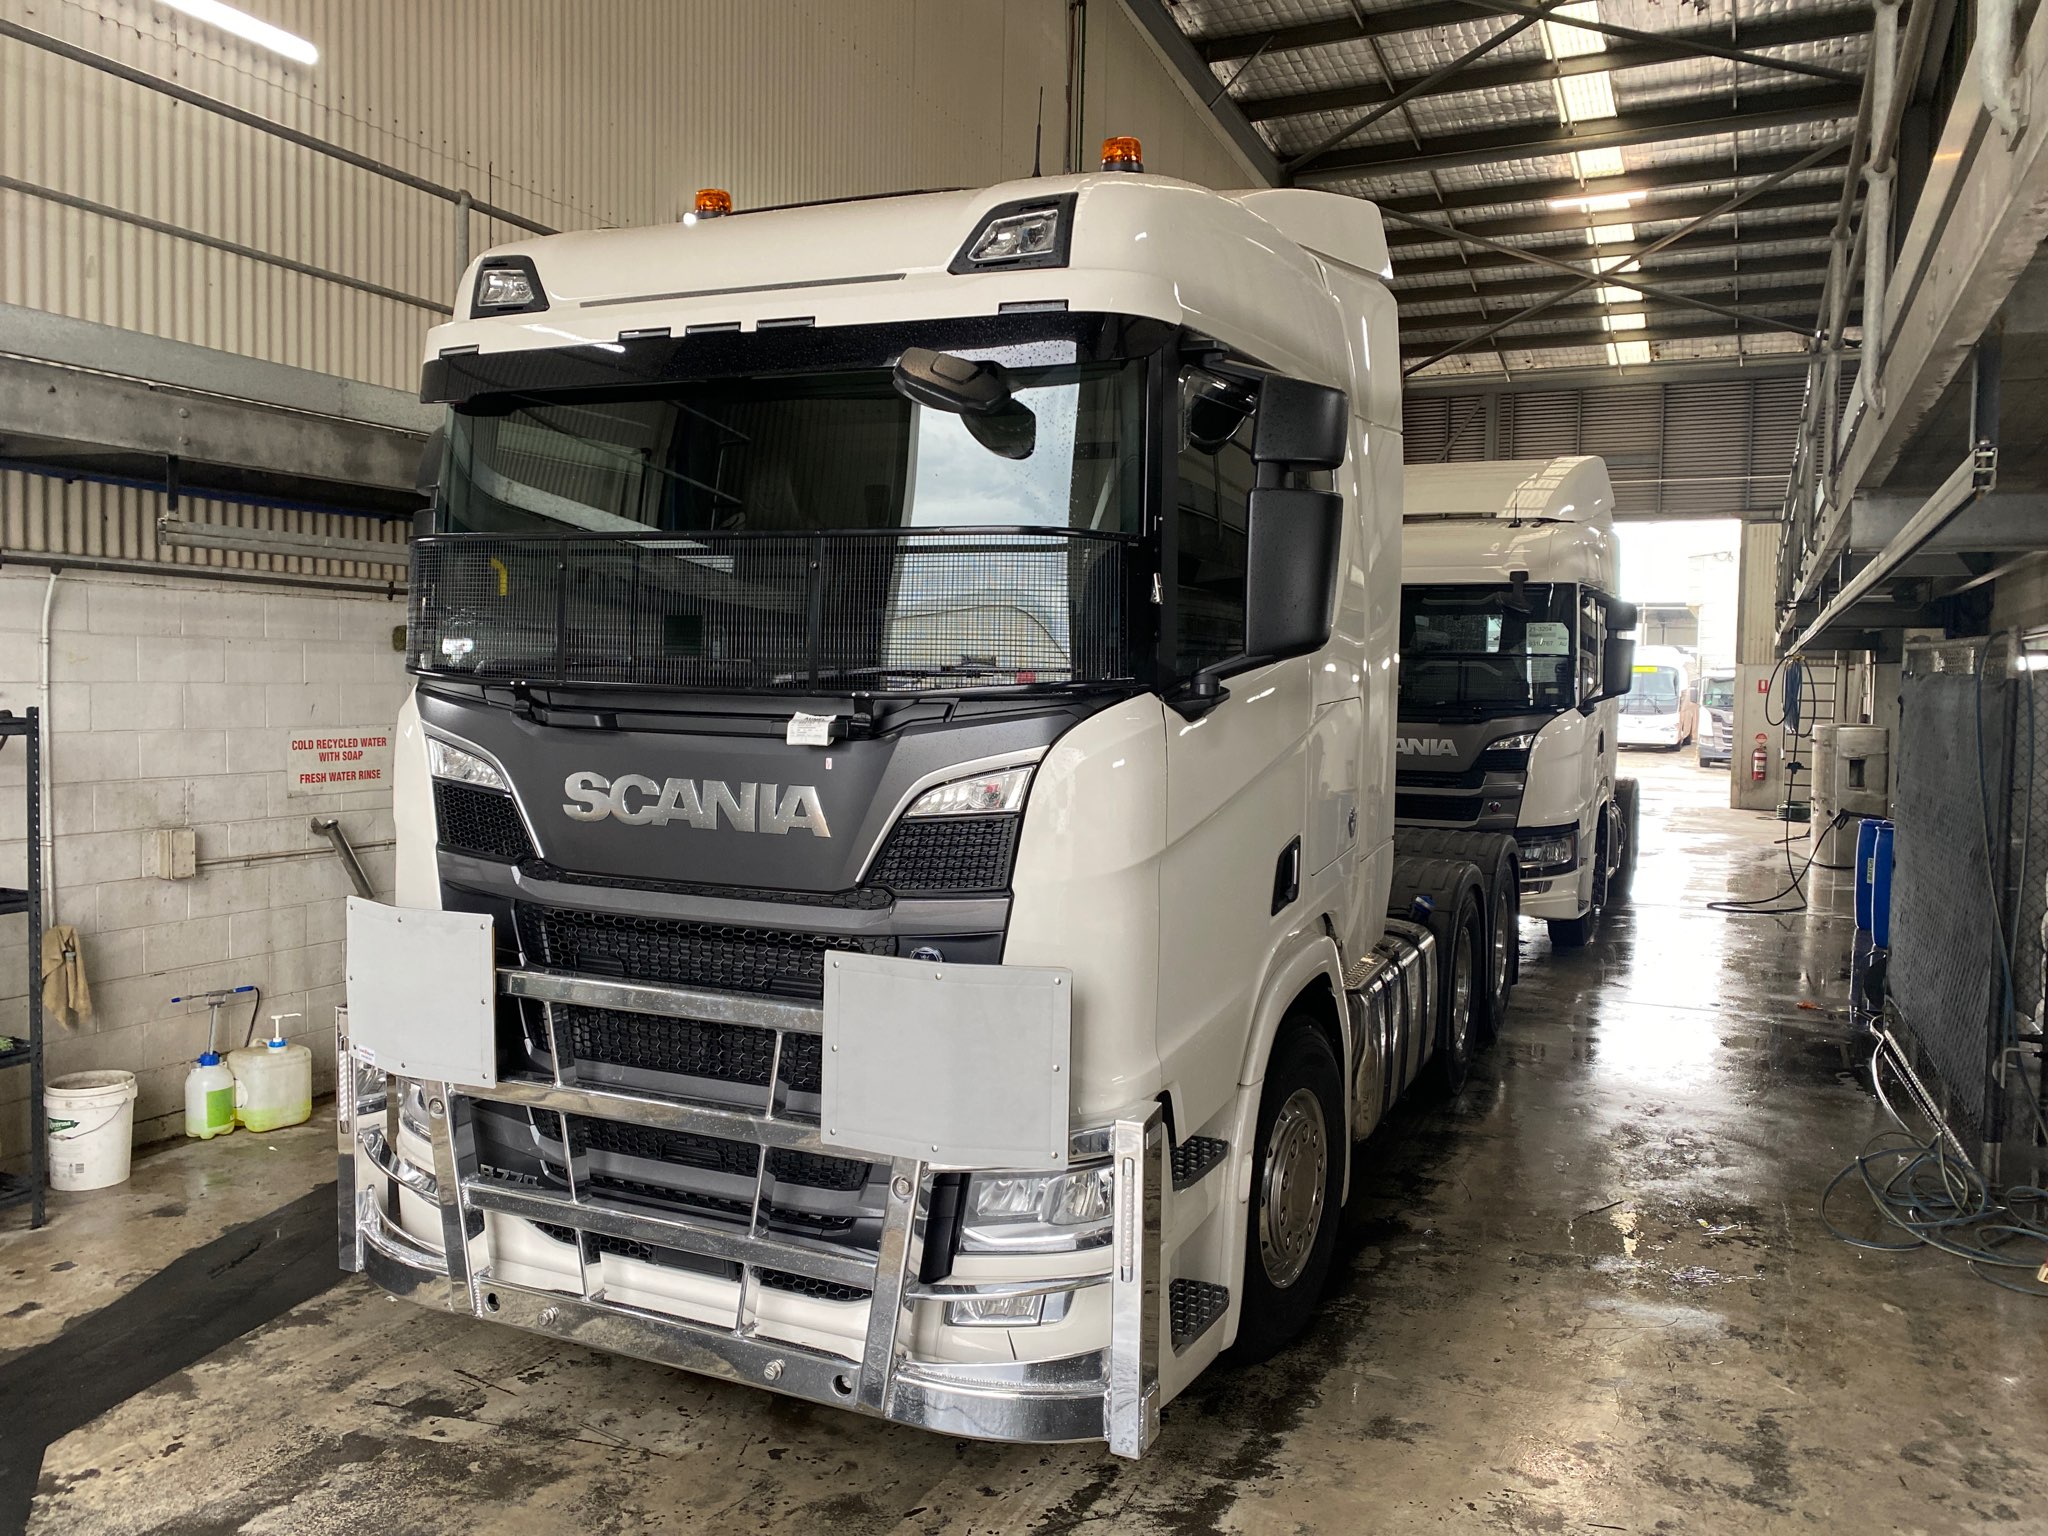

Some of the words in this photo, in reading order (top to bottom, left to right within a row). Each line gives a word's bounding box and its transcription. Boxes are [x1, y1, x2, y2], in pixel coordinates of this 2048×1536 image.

[292, 740, 314, 751] COLD
[316, 738, 358, 750] RECYCLED
[360, 737, 387, 748] WATER
[319, 751, 340, 762] WITH
[342, 750, 364, 761] SOAP
[300, 772, 327, 784] FRESH
[329, 770, 357, 782] WATER
[358, 769, 381, 780] RINSE
[562, 771, 832, 838] SCANIA
